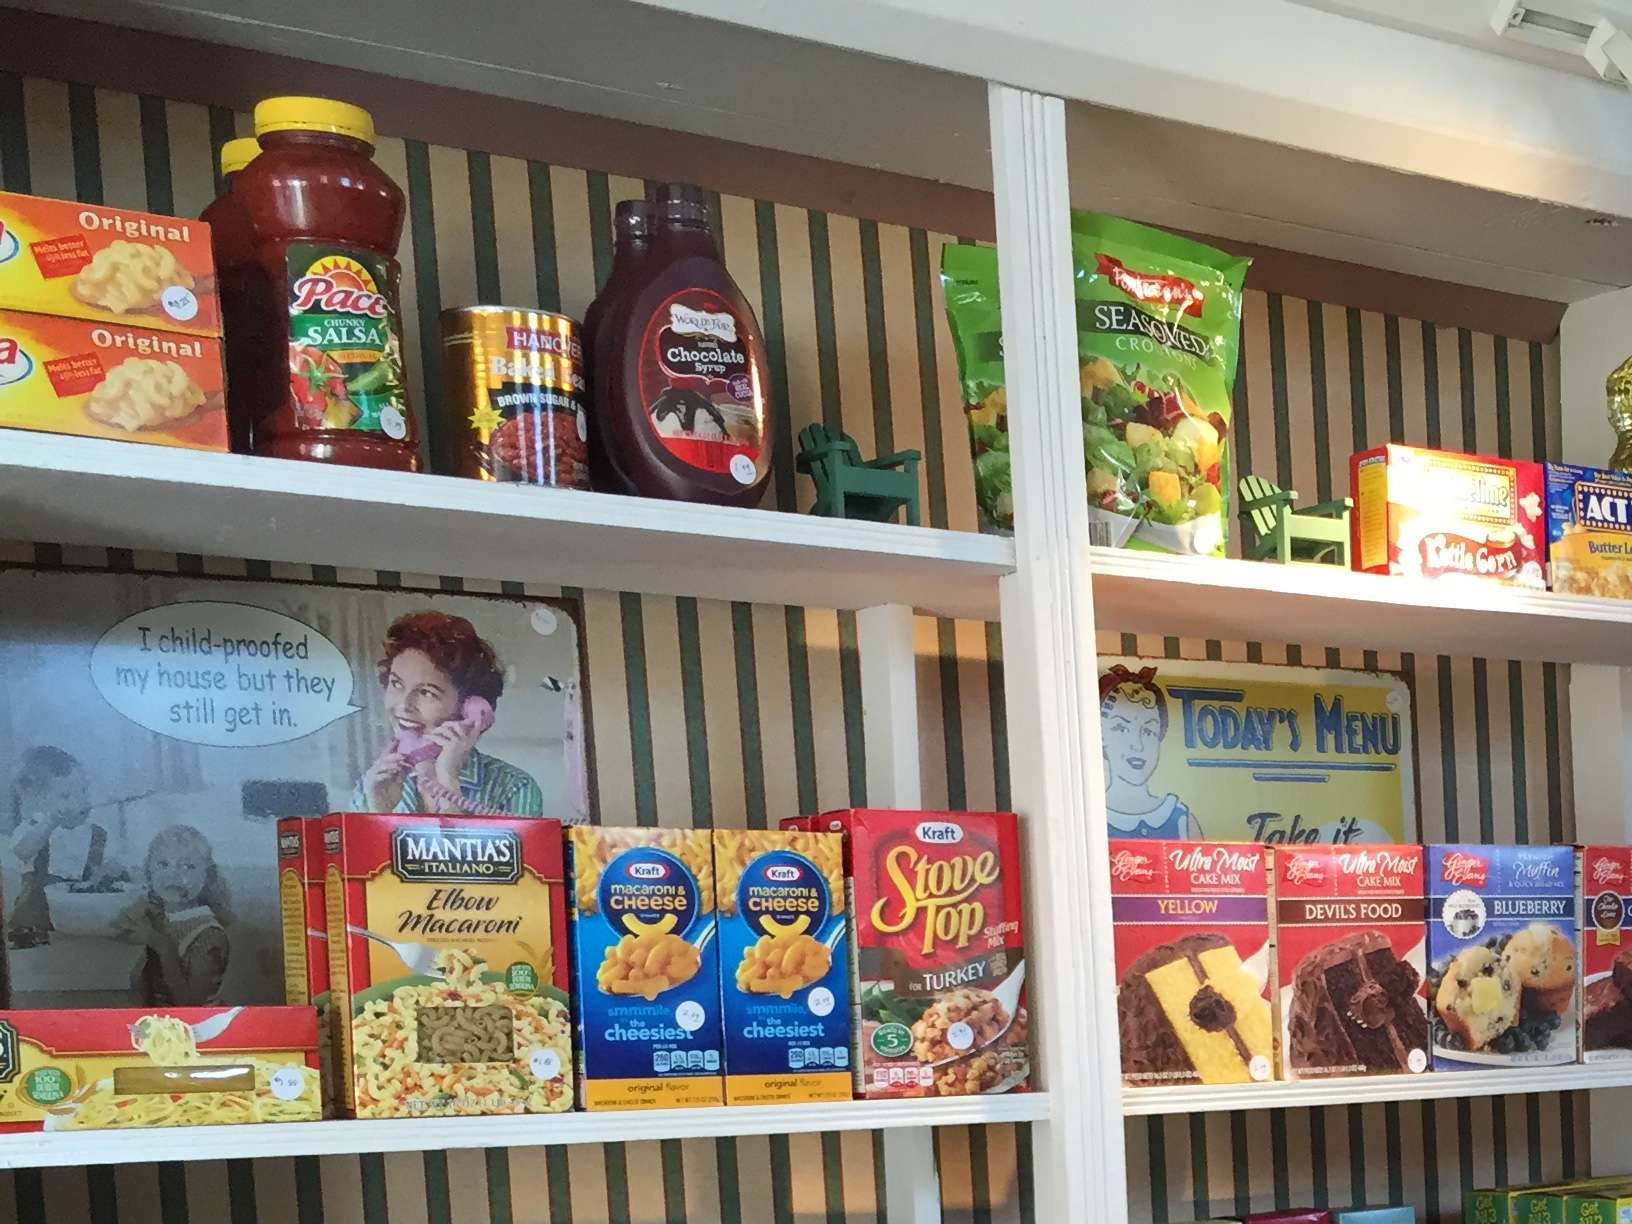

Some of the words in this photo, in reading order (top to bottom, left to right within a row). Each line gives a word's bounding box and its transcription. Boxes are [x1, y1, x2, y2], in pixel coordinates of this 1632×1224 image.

[79, 211, 191, 242] Original
[324, 318, 366, 329] CHUNKY
[1094, 304, 1209, 356] SEASONED
[91, 329, 202, 358] Original
[307, 326, 383, 346] SALSA
[512, 329, 583, 361] HANOVE
[667, 347, 745, 364] Chocolate
[1116, 336, 1198, 370] CROTONS
[695, 362, 726, 373] Syrup
[540, 393, 569, 407] SUGAR
[1586, 495, 1627, 525] ACT
[1588, 541, 1623, 555] Butter
[1476, 547, 1517, 574] Corn
[138, 628, 153, 652] I
[158, 627, 309, 661] child-proofed
[115, 668, 150, 691] my
[158, 661, 227, 690] house
[236, 666, 274, 693] but
[282, 668, 336, 698] they
[169, 699, 215, 726] still
[224, 705, 264, 734] get
[272, 700, 298, 728] in.
[922, 826, 957, 841] Kraft
[1246, 811, 1320, 846] Take
[1333, 816, 1364, 845] it
[407, 838, 511, 862] MANTIA'S
[1212, 847, 1260, 873] Moist
[424, 863, 494, 874] ITALIANO
[634, 865, 661, 877] Kraft
[1377, 850, 1419, 875] Moist
[1512, 861, 1560, 880] Muffin
[770, 868, 795, 880] Kraft
[1190, 873, 1219, 885] CAKE
[1220, 873, 1241, 885] MIX
[1357, 876, 1381, 887] CAKE
[1382, 876, 1402, 887] MIX
[610, 884, 675, 896] macaroni
[749, 886, 809, 898] macaroni
[871, 845, 1000, 933] Stove
[426, 888, 500, 911] Elbow
[1158, 899, 1219, 914] YELLOW
[1494, 900, 1567, 915] BLUEBERRY
[1305, 903, 1357, 920] DEVIL'S
[1360, 902, 1402, 919] FOOD
[398, 911, 522, 934] Macaroni
[918, 898, 985, 956] Top
[922, 960, 986, 992] TURKEY
[604, 1023, 693, 1042] cheesiest
[743, 1022, 825, 1040] cheesiest
